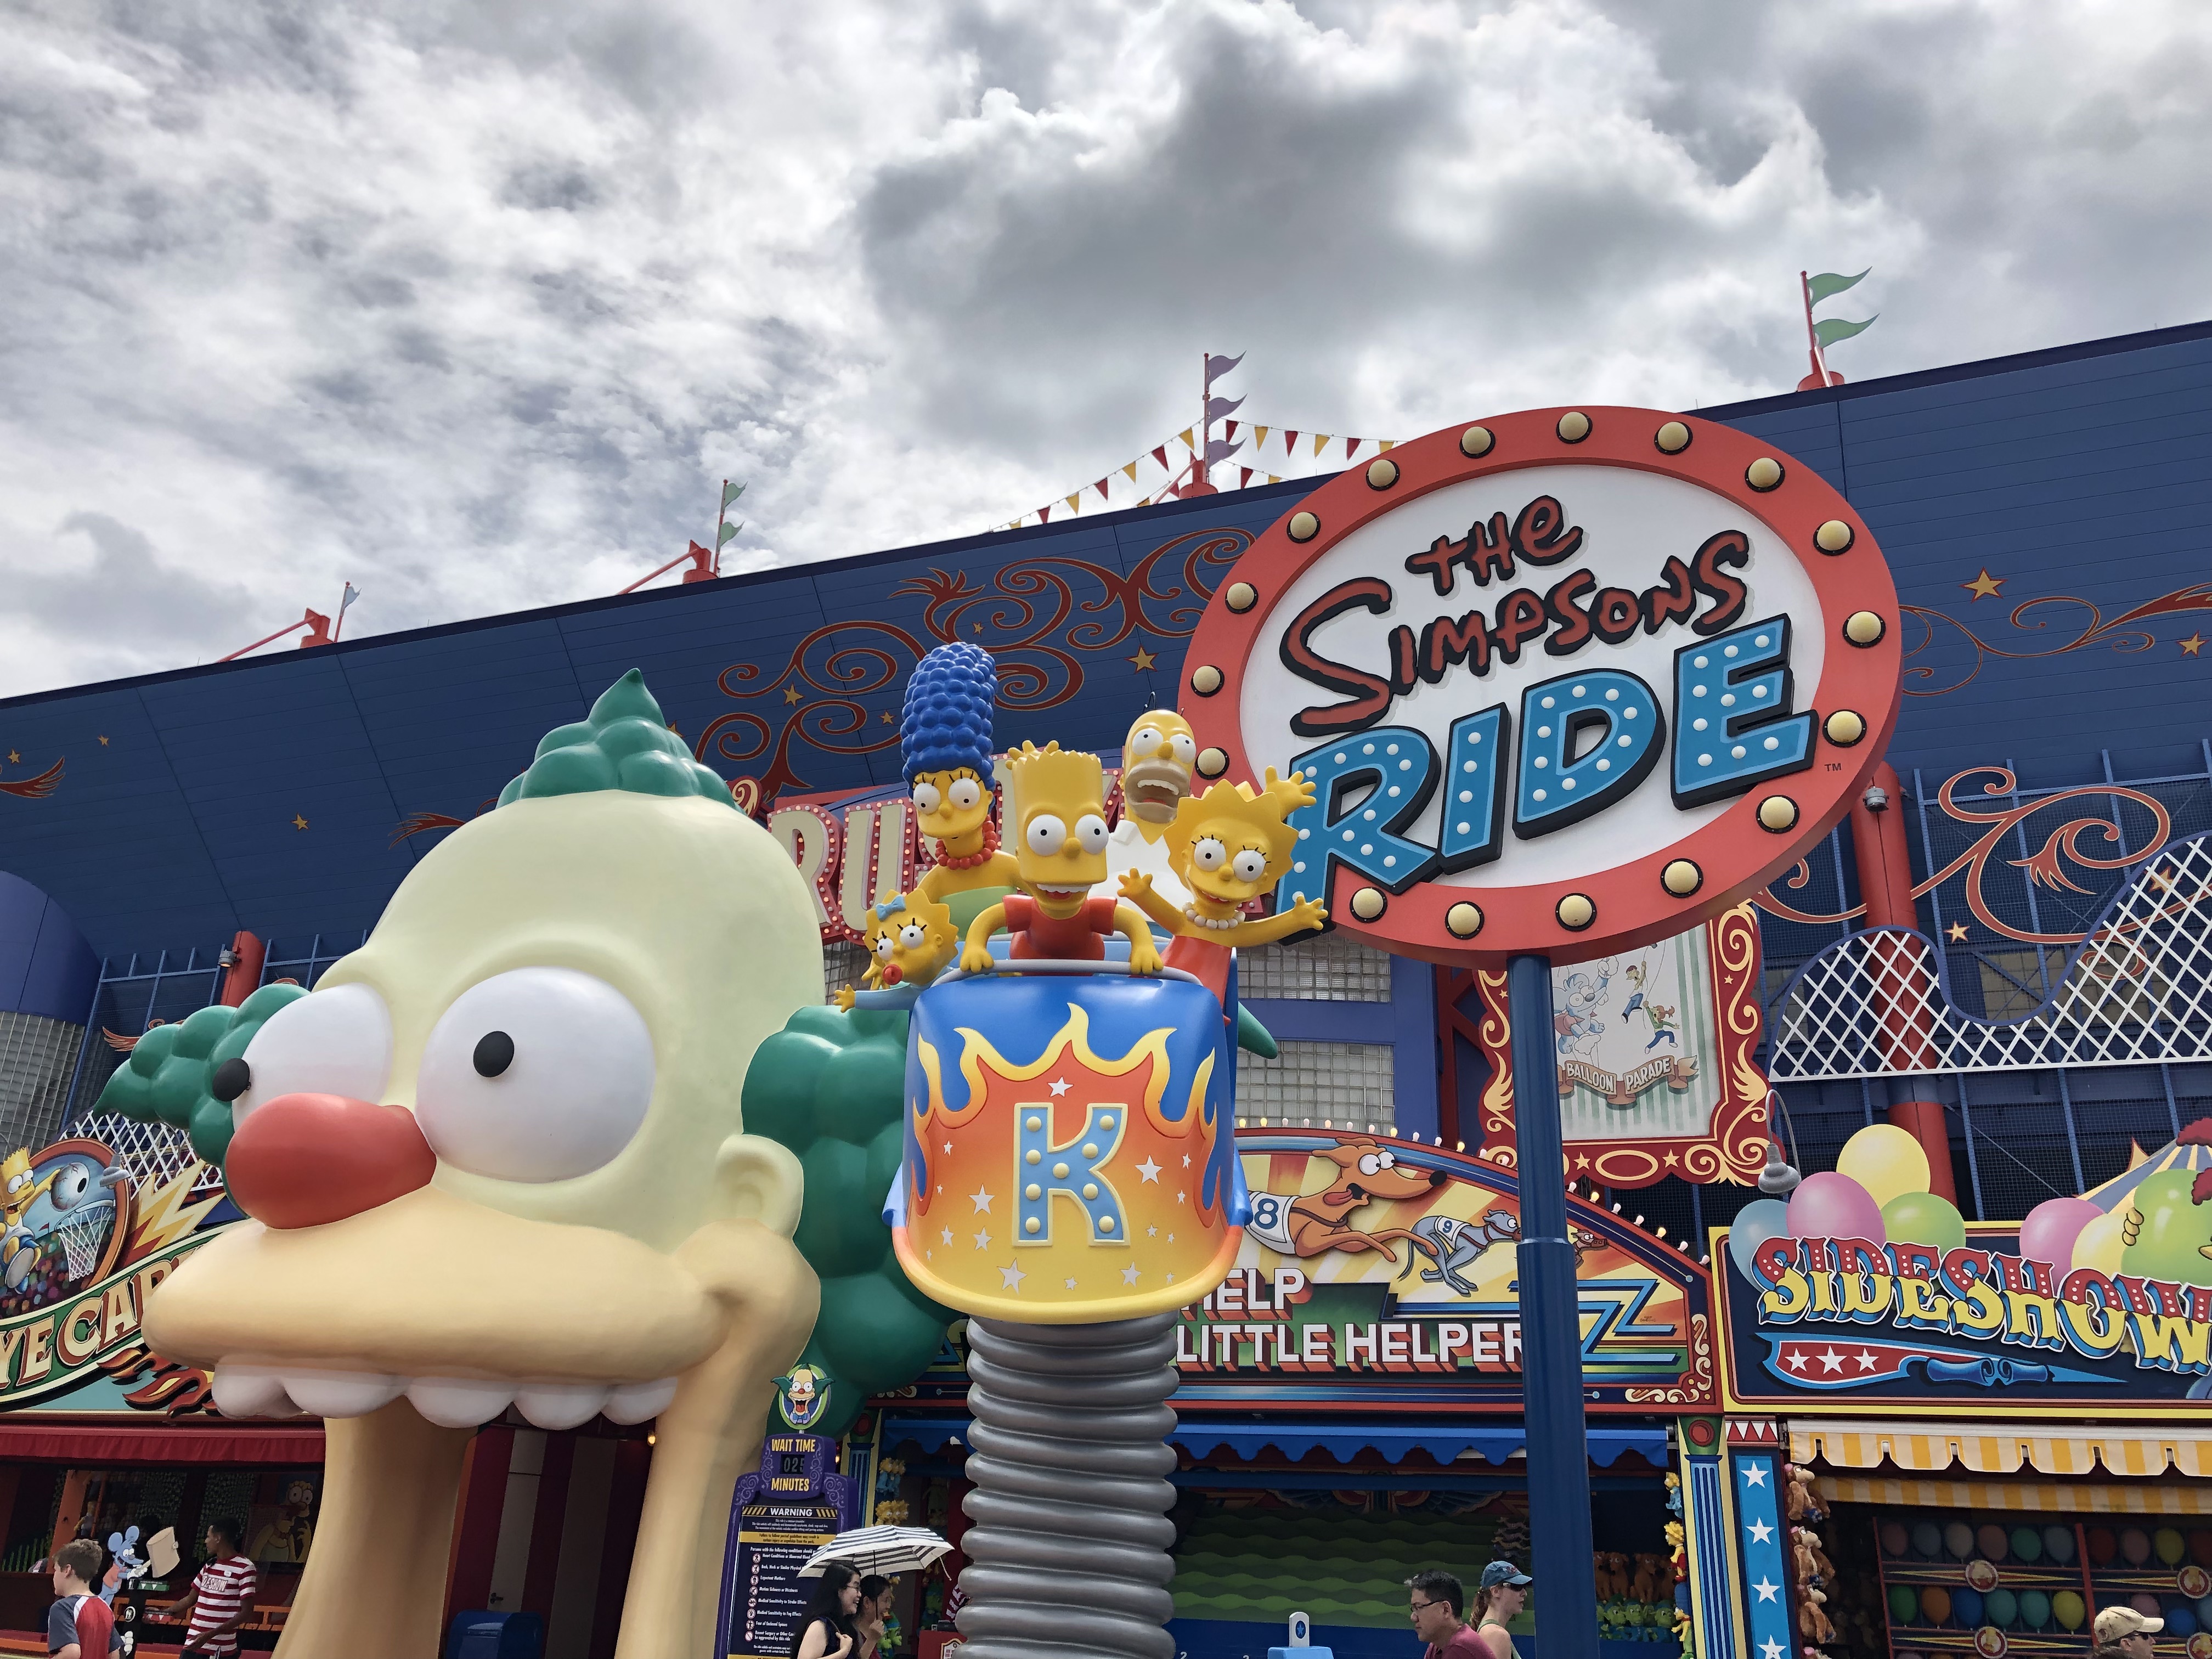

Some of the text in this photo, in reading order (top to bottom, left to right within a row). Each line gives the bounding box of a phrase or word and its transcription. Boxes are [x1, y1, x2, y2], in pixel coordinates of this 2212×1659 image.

[1277, 612, 1819, 945] RIDE
[1824, 763, 1841, 771] TM
[1566, 1057, 1672, 1093] BALLOON PARADE
[1013, 1102, 1130, 1246] K
[1254, 1198, 1280, 1229] 8
[1441, 1218, 1454, 1234] 9
[1751, 1235, 2212, 1376] SIDESHOW
[1176, 1322, 1522, 1365] LITTLE HELPER
[771, 1439, 816, 1452] WAIT TIME
[771, 1478, 810, 1491] MINUTES
[770, 1508, 812, 1516] WARNING
